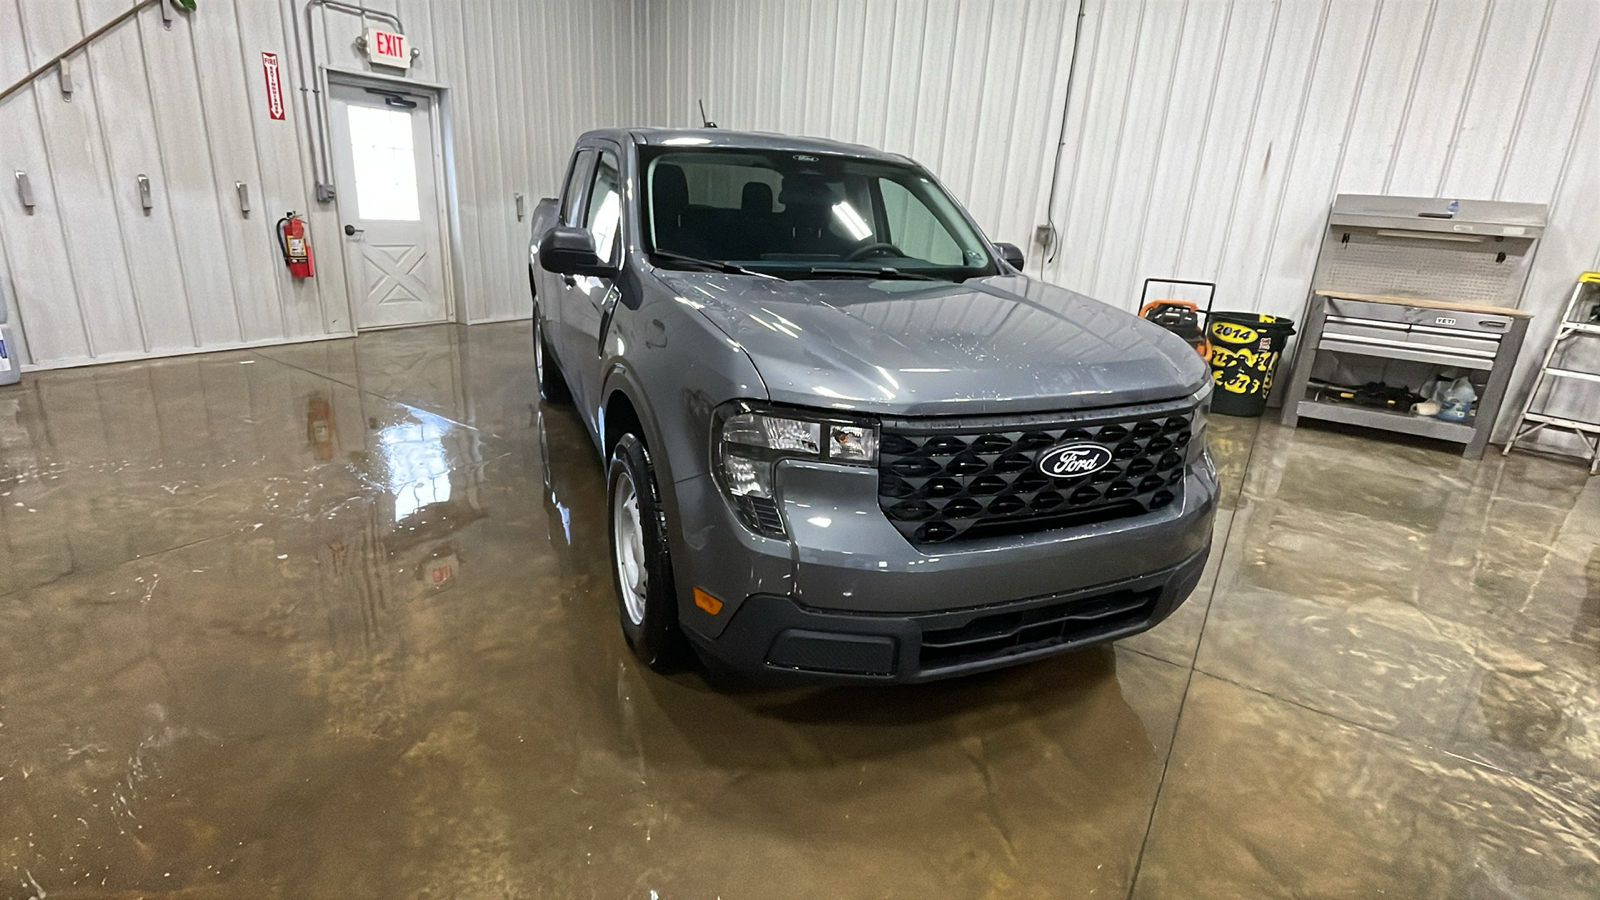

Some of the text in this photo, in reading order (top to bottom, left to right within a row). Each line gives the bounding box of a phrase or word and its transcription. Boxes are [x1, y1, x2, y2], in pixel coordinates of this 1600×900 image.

[376, 32, 403, 58] EXIT
[264, 57, 276, 66] FIRE
[1214, 324, 1252, 340] 2014
[1053, 449, 1100, 473] Ford
